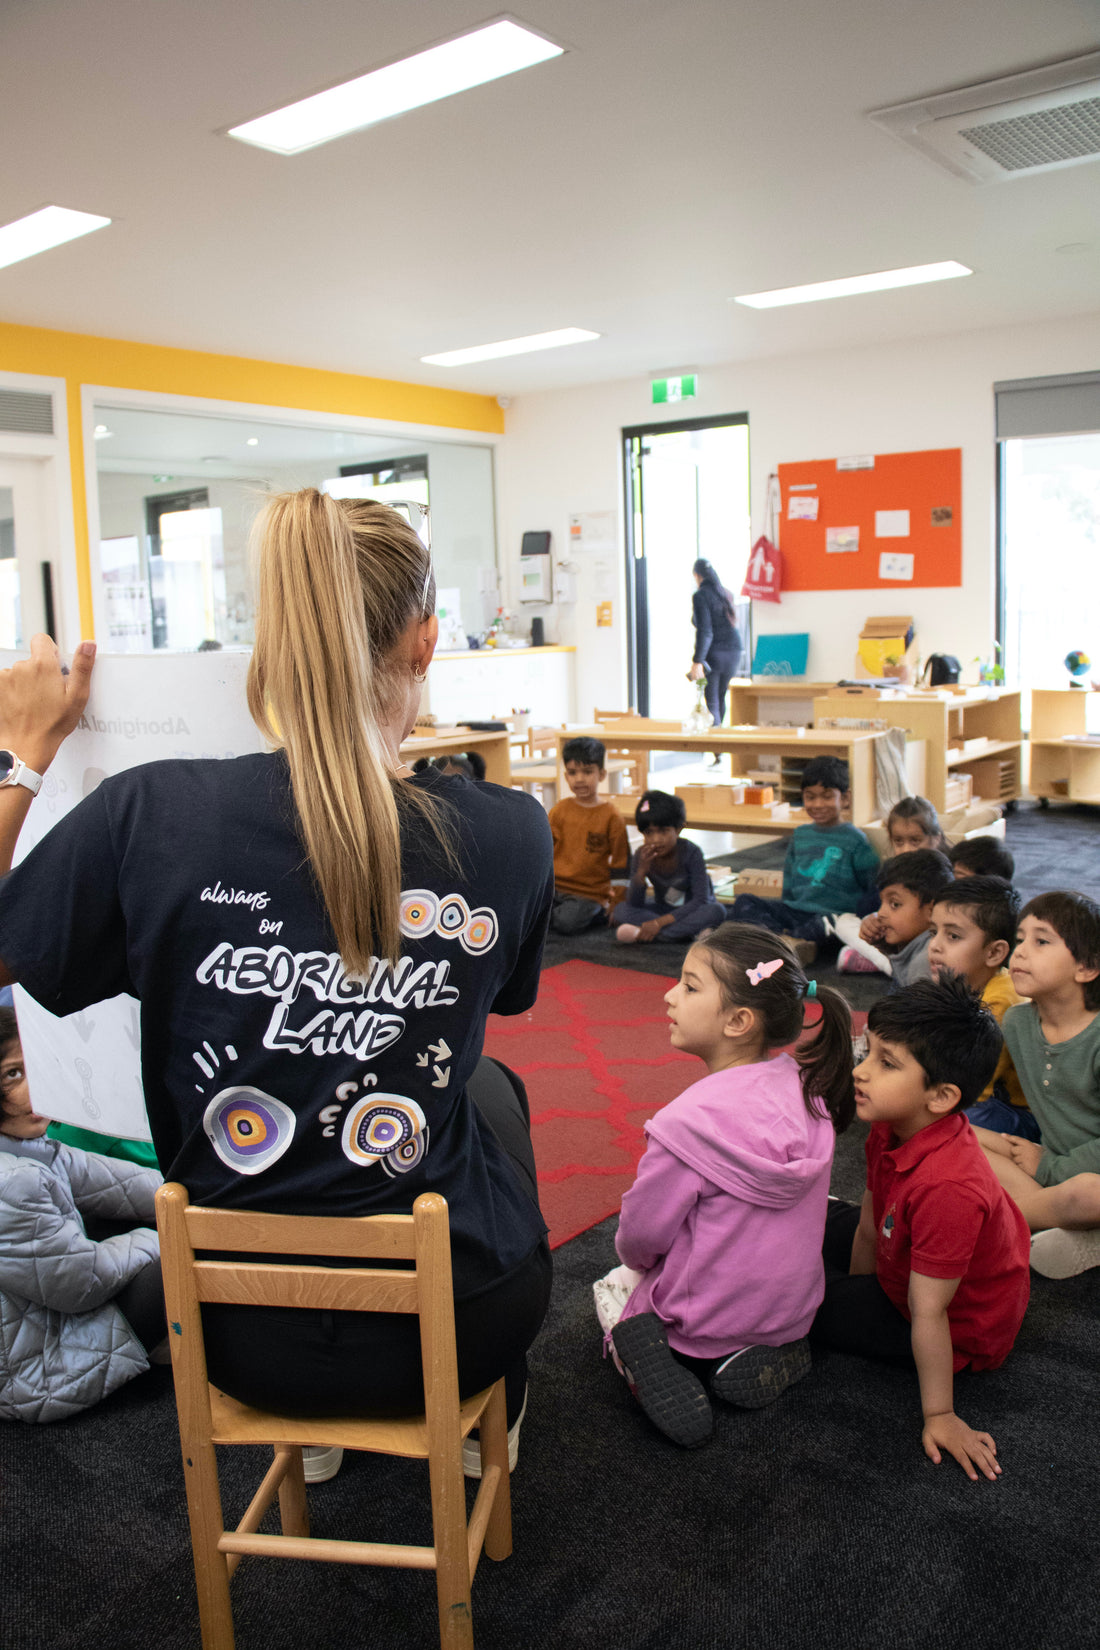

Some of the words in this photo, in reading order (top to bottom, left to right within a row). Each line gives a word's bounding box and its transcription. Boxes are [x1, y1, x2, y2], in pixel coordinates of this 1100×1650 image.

[200, 880, 271, 912] always
[258, 918, 284, 936] on
[196, 942, 460, 1009] ABORIGINAL
[262, 1001, 406, 1061] LAND
